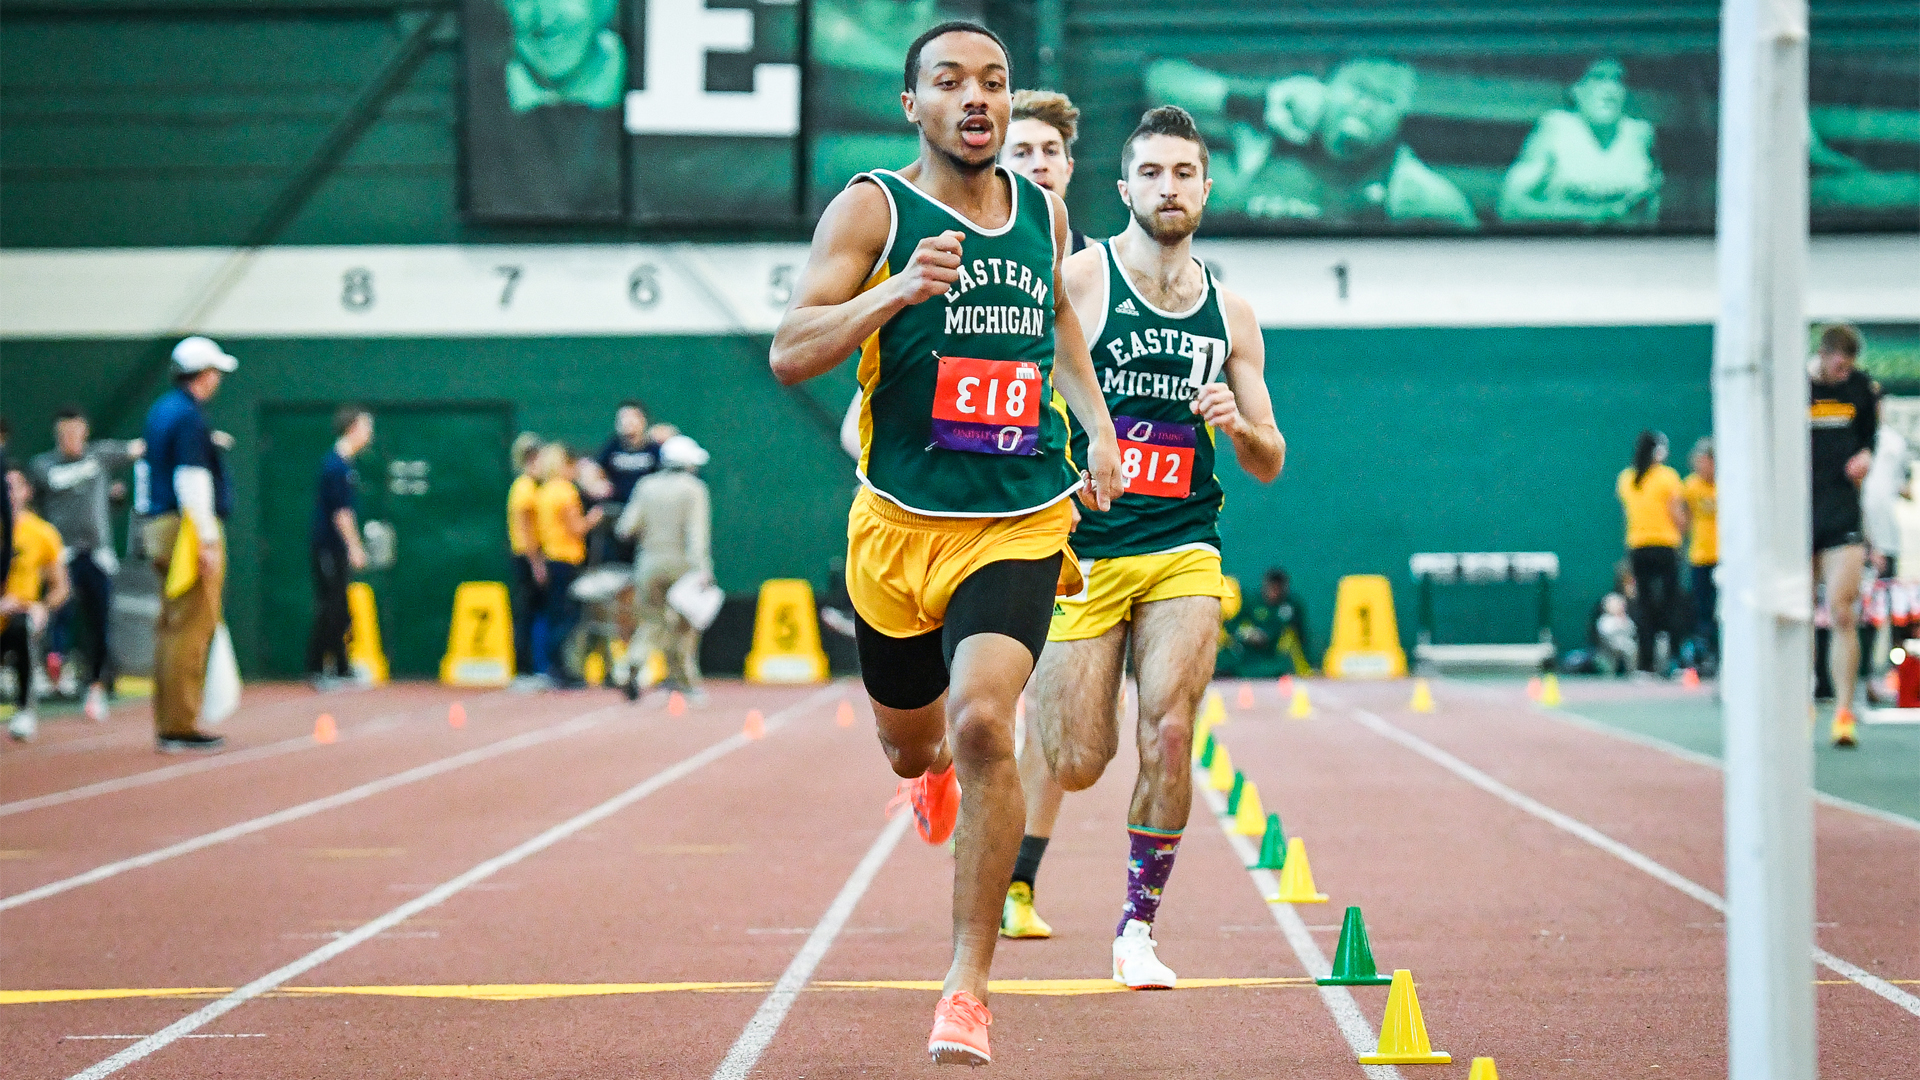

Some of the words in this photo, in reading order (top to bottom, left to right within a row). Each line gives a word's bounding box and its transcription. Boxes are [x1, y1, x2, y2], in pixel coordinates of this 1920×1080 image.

[624, 0, 800, 135] E
[341, 266, 376, 314] 8
[496, 265, 524, 307] 7
[628, 265, 661, 311] 6
[766, 265, 794, 309] 5
[1333, 264, 1349, 301] 1
[944, 305, 1044, 337] MICHIGAN
[1106, 328, 1194, 367] EASTE
[1199, 342, 1214, 386] 1
[1102, 367, 1199, 400] MICHIG
[1121, 447, 1181, 483] 812
